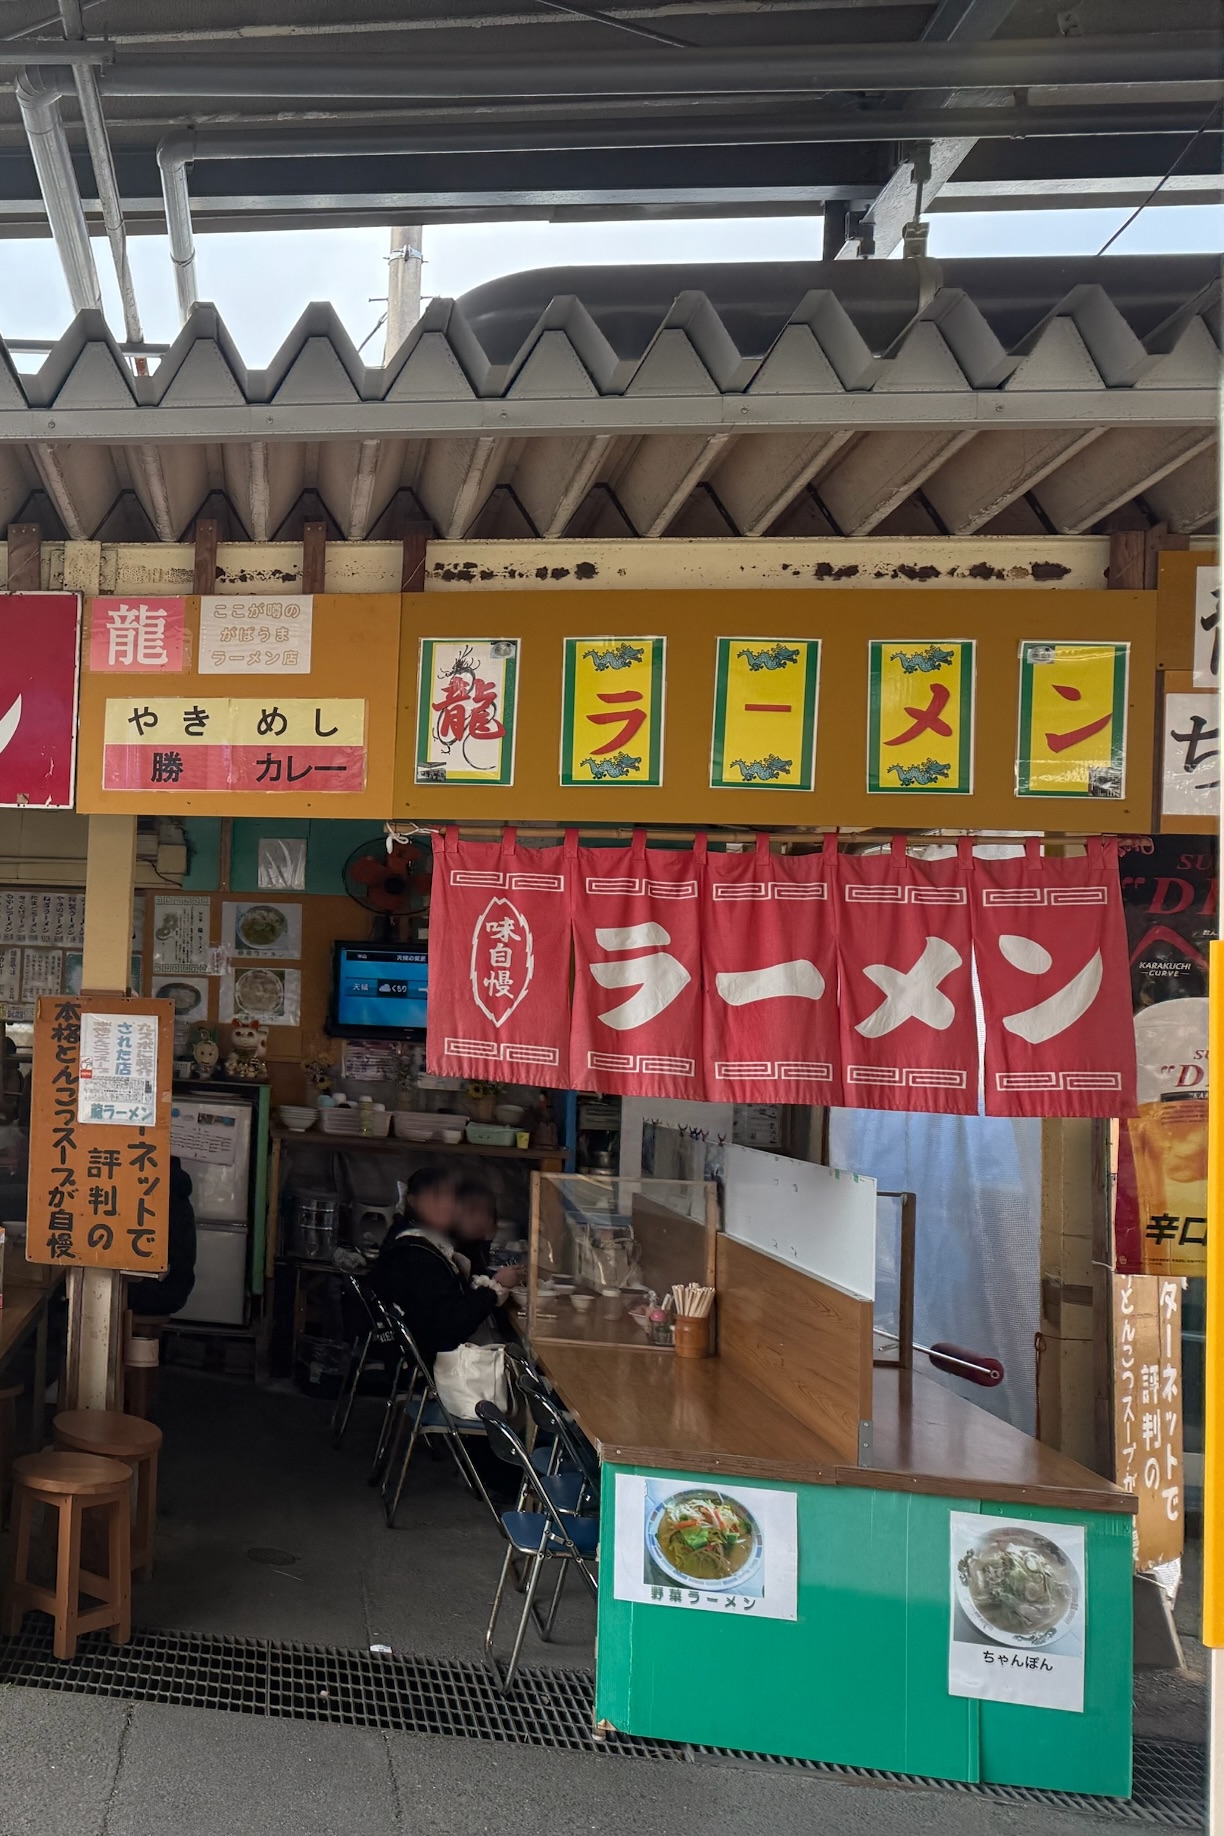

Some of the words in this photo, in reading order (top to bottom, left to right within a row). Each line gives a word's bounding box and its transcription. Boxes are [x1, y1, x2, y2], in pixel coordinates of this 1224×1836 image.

[214, 602, 300, 619] ここが噂の
[107, 603, 168, 666] 龍
[220, 626, 289, 642] がばうま
[211, 650, 298, 666] ラーメン店
[128, 704, 340, 738] やきめし
[585, 683, 1113, 755] ラーメン
[482, 915, 523, 1000] 味自慢
[1139, 961, 1191, 970] KARAKUCHI
[392, 985, 407, 993] くもり
[589, 920, 1104, 1045] ラーメン
[115, 1022, 132, 1076] された店
[46, 1002, 81, 1259] 本格とんこつスープが自慢
[87, 1147, 122, 1251] 評判の
[1141, 1364, 1162, 1490] 評判の
[651, 1586, 756, 1610] 野菜ラーメン
[983, 1650, 1054, 1671] ちゃんぽん
